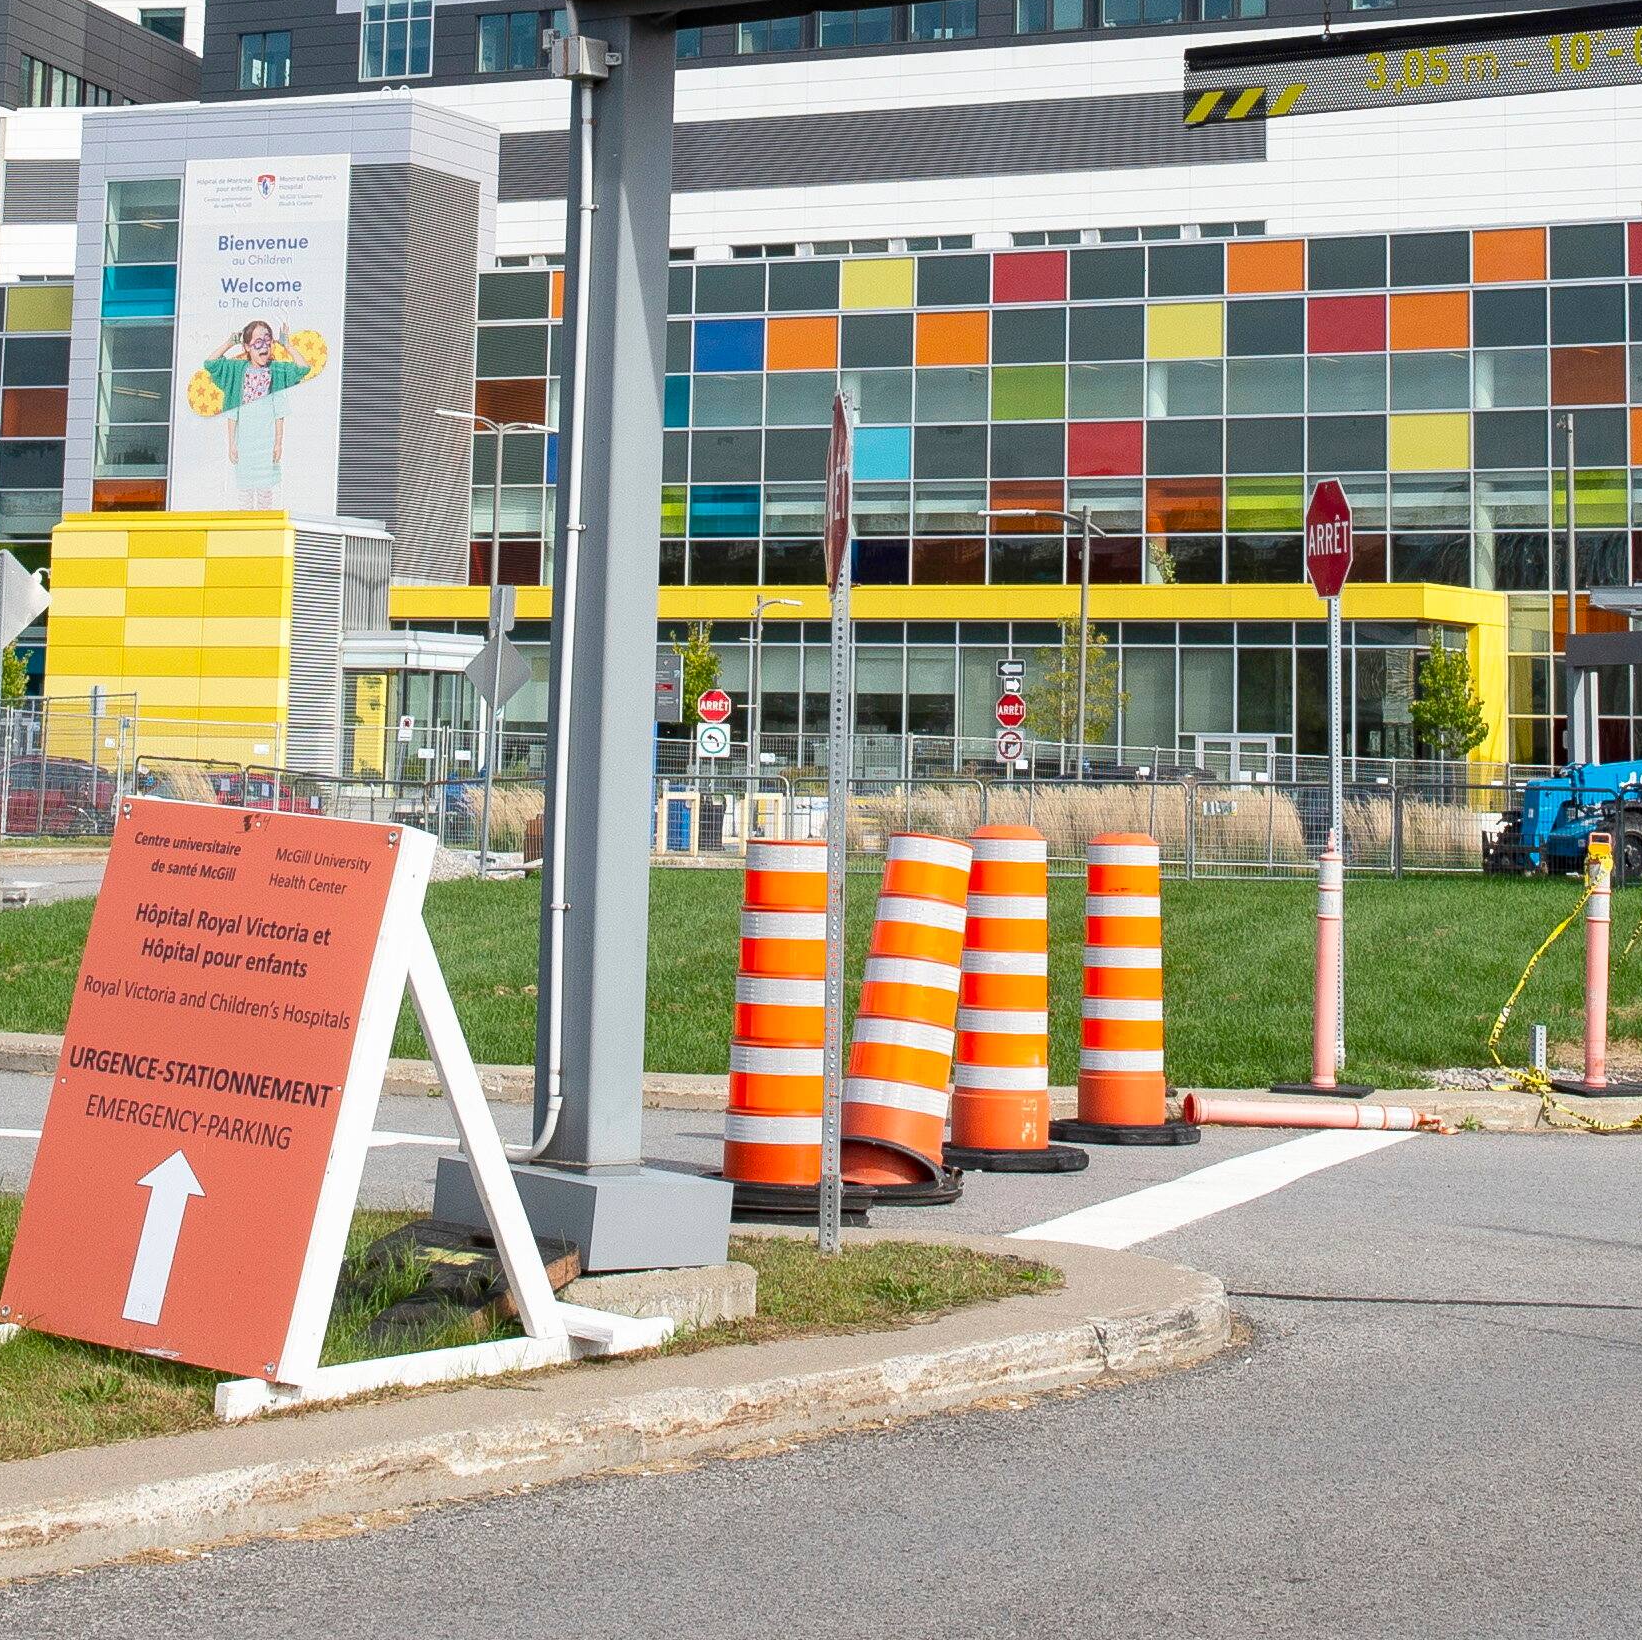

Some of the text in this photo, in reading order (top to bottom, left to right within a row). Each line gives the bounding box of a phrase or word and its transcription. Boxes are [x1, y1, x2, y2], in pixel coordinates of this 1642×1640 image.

[1366, 49, 1450, 94] 3,05
[1463, 53, 1499, 83] m
[218, 235, 309, 251] Bienvenue
[248, 254, 293, 265] Children
[221, 277, 302, 293] Welcome
[218, 296, 304, 308] to The Children's
[1308, 514, 1349, 557] ARRÊT
[700, 700, 729, 712] ARRÊT
[998, 703, 1024, 716] ARRÊT
[134, 831, 241, 856] Centre universitaire
[151, 859, 236, 881] de santé McGill
[275, 848, 371, 873] McGill University
[269, 873, 347, 895] Health Center
[135, 903, 332, 946] Hôpital Royal Victoria et
[141, 937, 308, 978] Hôpital pour enfants
[83, 975, 350, 1030] Royal Victoria and Children's Hospitals
[69, 1045, 333, 1109] URGENCE-STATIONNEMENT
[85, 1094, 293, 1150] EMERGENCY-PARKING
